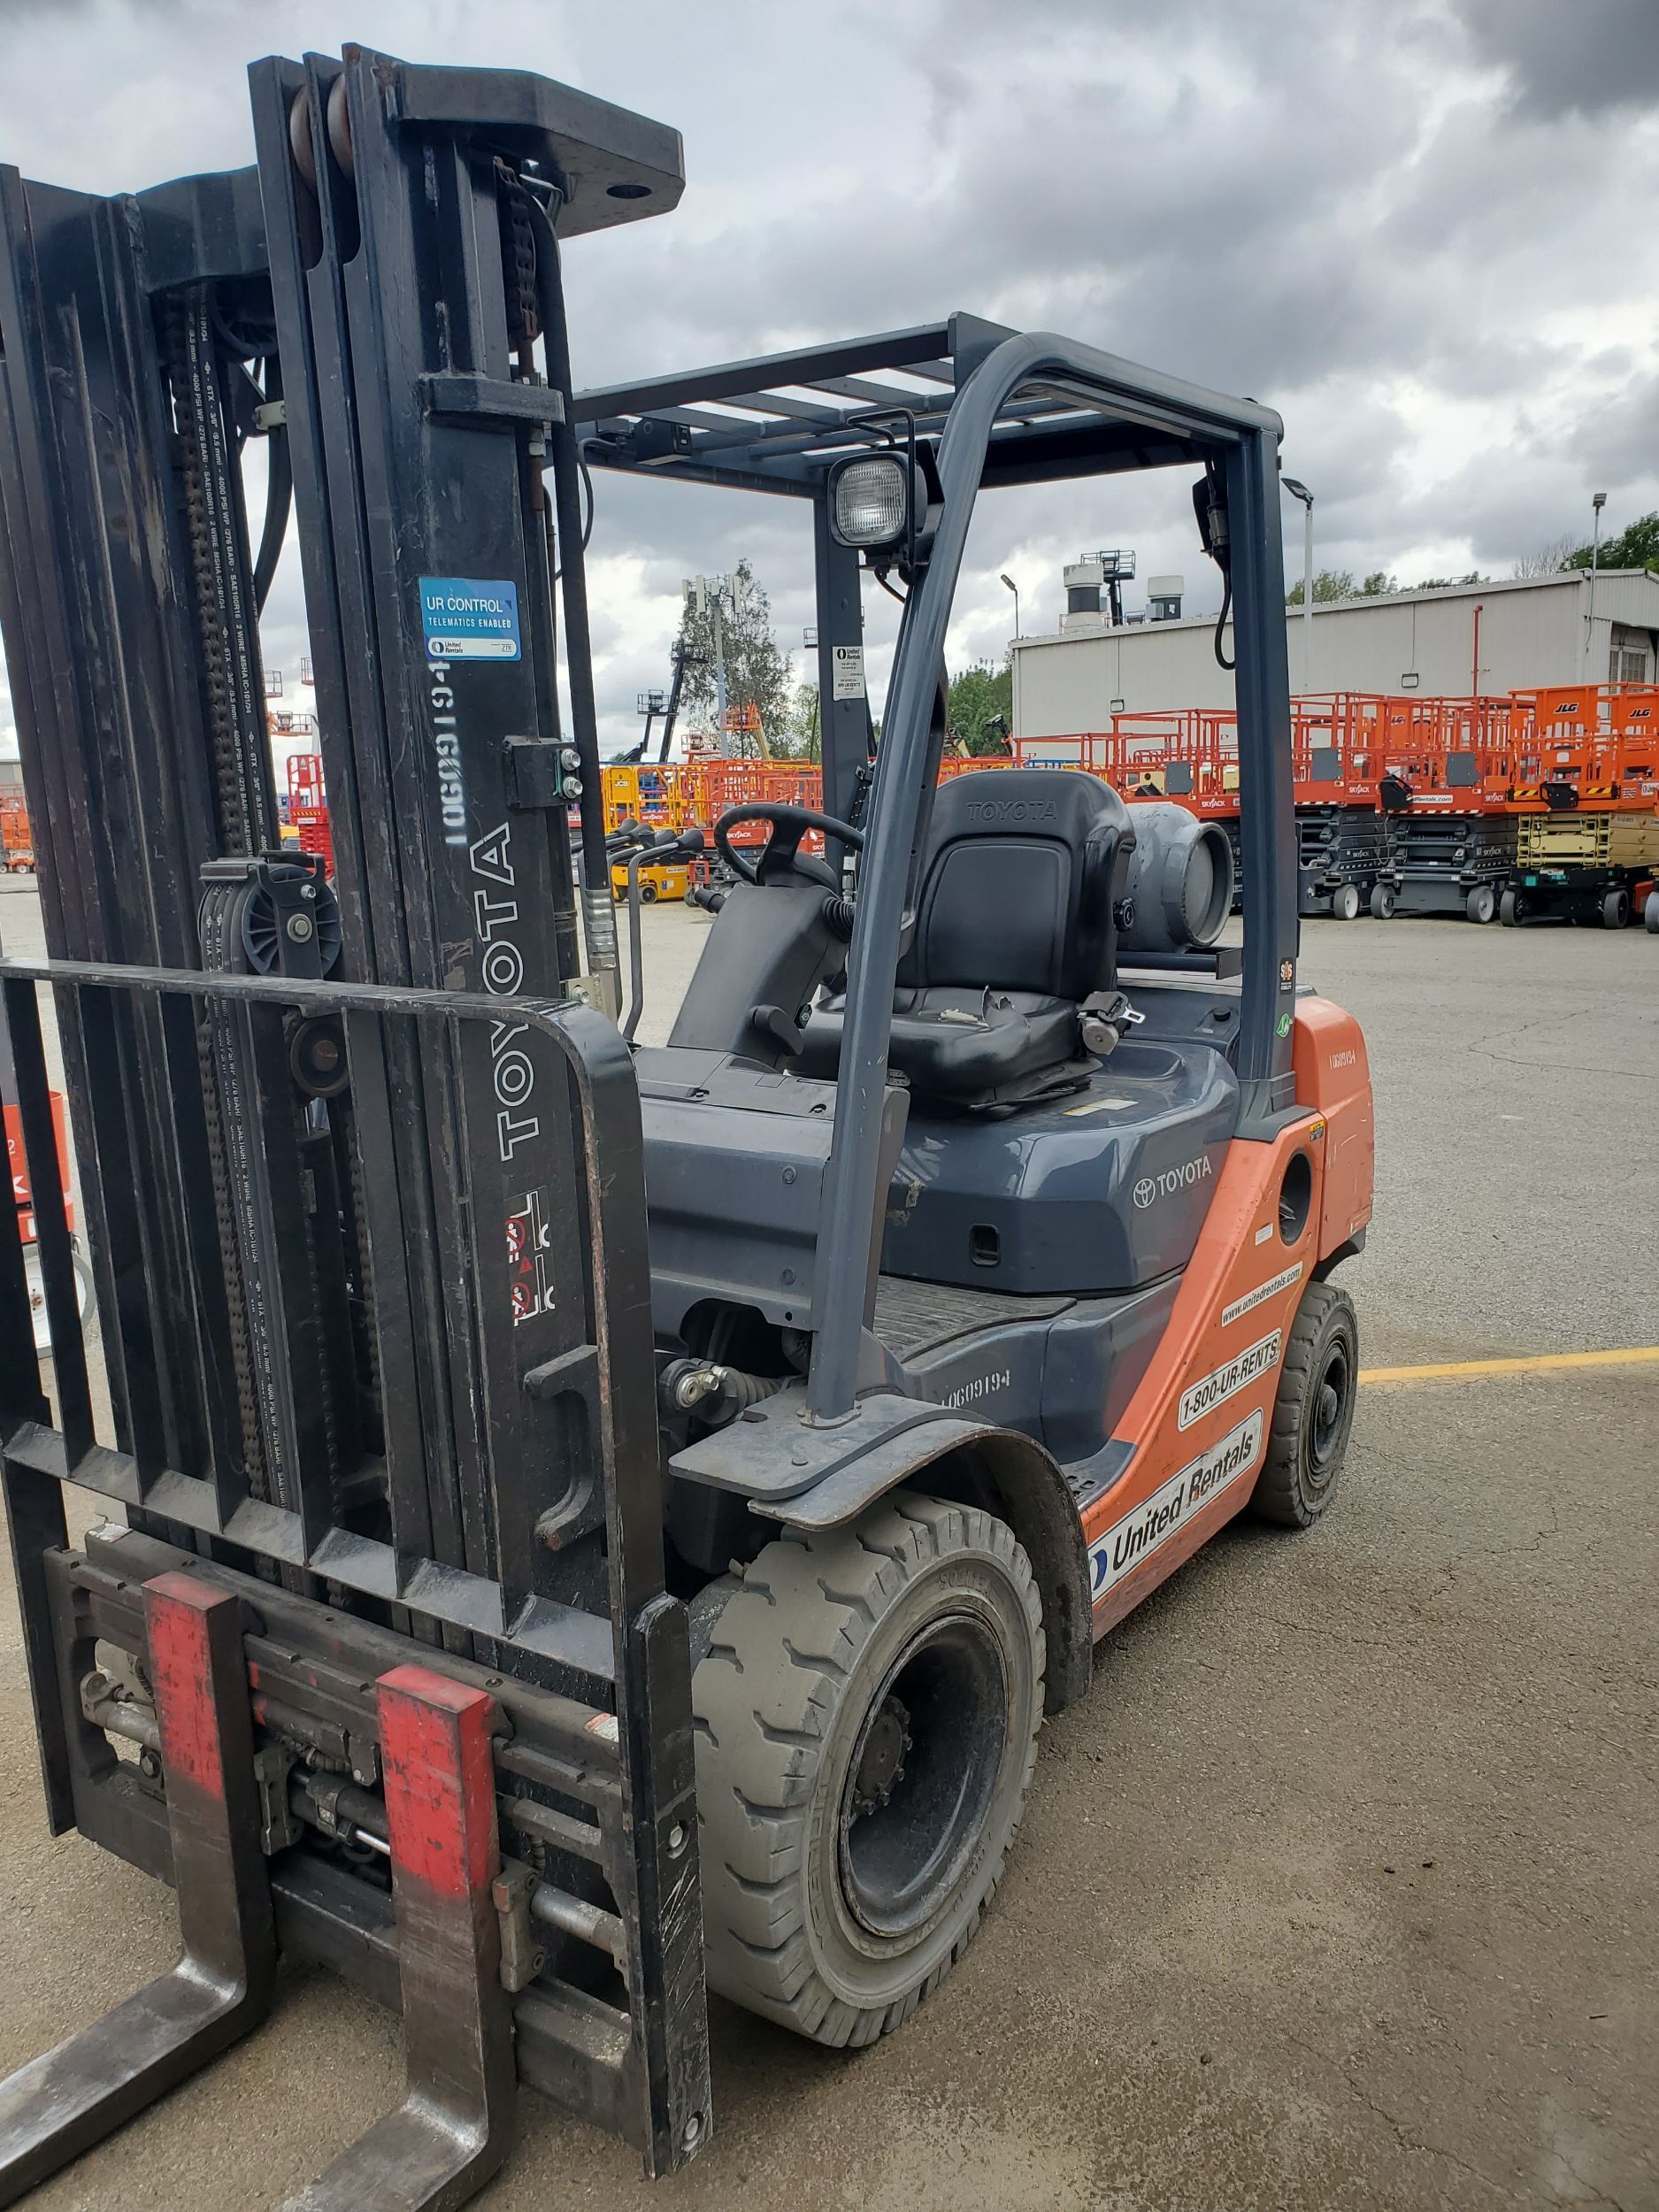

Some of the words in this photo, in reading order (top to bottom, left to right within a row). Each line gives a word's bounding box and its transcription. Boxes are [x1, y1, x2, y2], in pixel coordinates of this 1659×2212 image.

[222, 511, 229, 525] WP
[226, 546, 234, 565] BAR)
[196, 408, 204, 421] WP
[204, 471, 214, 515] SAE100R16
[215, 575, 225, 609] IC-101/34
[236, 762, 243, 773] WP
[229, 574, 241, 618] SAE100R16
[426, 596, 444, 611] UR
[448, 597, 503, 612] CONTROL
[428, 618, 474, 626] TELEMATICS
[479, 618, 511, 628] ENABLED
[242, 680, 251, 713] IC-101/34
[1554, 703, 1578, 713] JLG
[1628, 708, 1651, 718] JLG
[1348, 784, 1370, 795] SKYJACK
[1485, 793, 1504, 802] SKYJACK
[966, 800, 1057, 821] TOYOTA
[1202, 798, 1225, 808] SKYJACK
[1483, 846, 1502, 856] SKYJACK
[469, 822, 540, 1161] TOYOTA
[1156, 1156, 1212, 1196] TOYOTA
[1223, 1267, 1301, 1324] www.unitedrentals.com
[1112, 1482, 1185, 1571] United
[1186, 1432, 1253, 1509] Rentals
